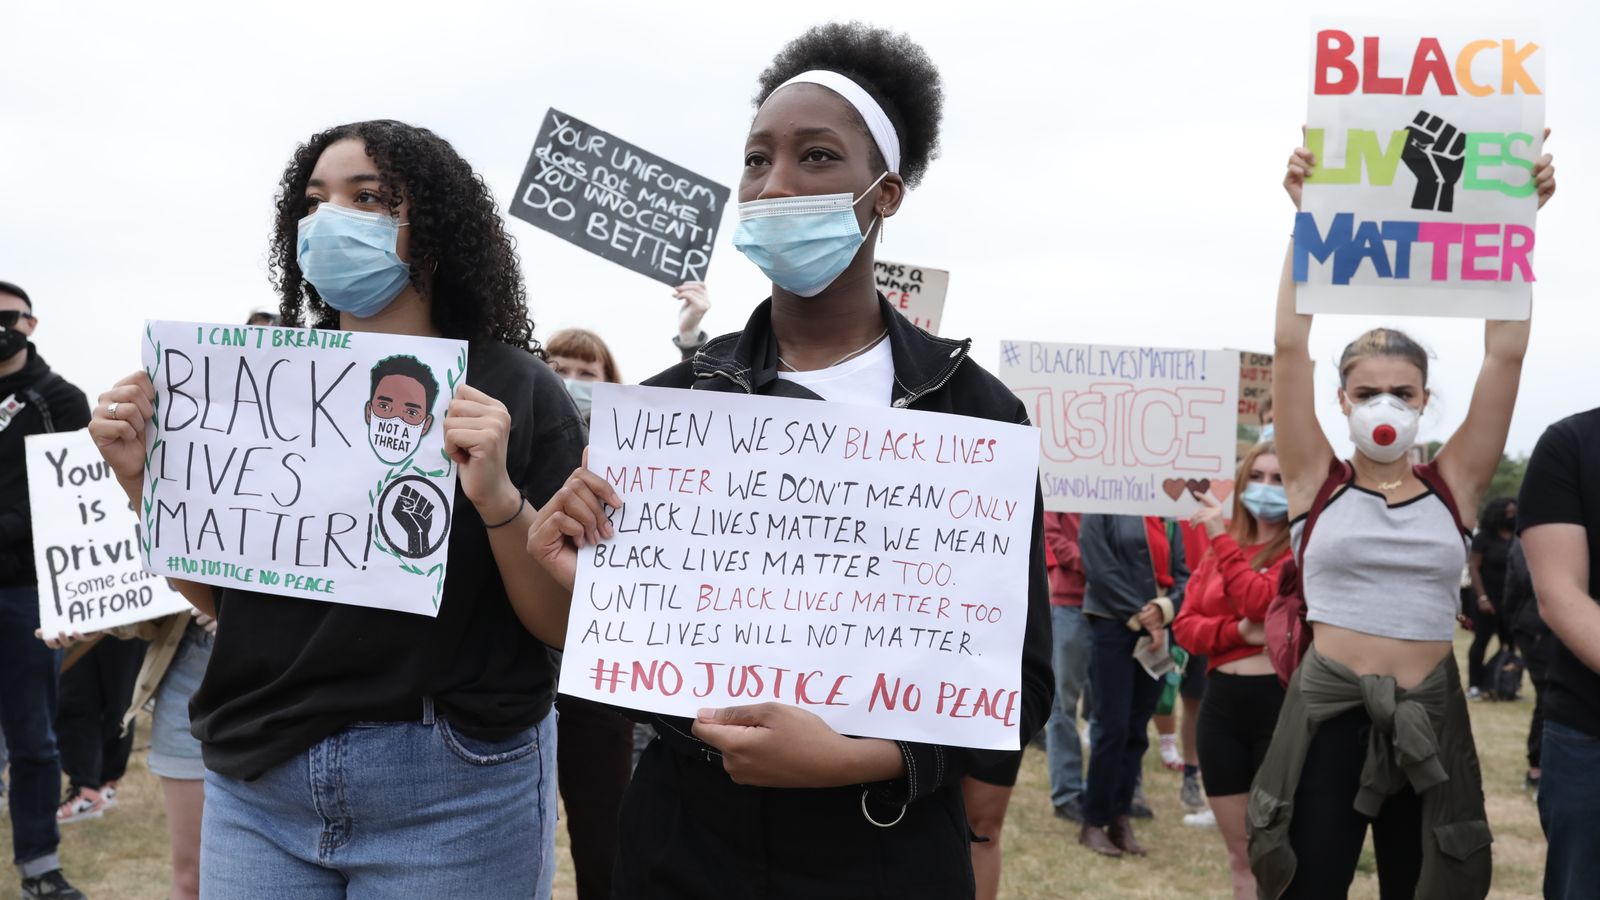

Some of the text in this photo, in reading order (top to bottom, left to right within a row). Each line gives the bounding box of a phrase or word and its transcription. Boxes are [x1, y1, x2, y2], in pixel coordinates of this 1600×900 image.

[1314, 30, 1542, 97] BLACK
[549, 114, 607, 158] YOUR
[1303, 128, 1538, 198] LIVES
[534, 144, 699, 224] does not MAKE
[534, 160, 713, 251] YOU INNOCENT!
[522, 183, 708, 282] DO BETTER
[1292, 212, 1537, 285] MATTER
[198, 327, 352, 349] I CAN'T BREATHE
[165, 349, 356, 448] BLACK
[374, 434, 411, 452] THREAT
[378, 422, 409, 438] NOT A
[613, 408, 996, 464] WHEN WE SAY BLACK LIVES
[160, 441, 306, 507] LIVES
[606, 466, 1018, 522] MATTER WE DON'T MEAN ONLY
[78, 495, 106, 525] is
[156, 500, 373, 571] MATTER!
[691, 506, 760, 536] LIVES
[766, 513, 867, 544] MATTER
[884, 526, 920, 552] WE
[934, 528, 1010, 556] MEAN
[166, 556, 336, 594] #NO JUSTICE NO PEACE
[594, 544, 956, 586] BLACK LIVES MATTER TOO.
[68, 585, 153, 624] AFFORD
[590, 582, 1002, 624] UNTIL BLACK LIVES MATTER TOO
[581, 620, 982, 656] ALL LIVES WILL NOT MATTER.
[590, 658, 1020, 726] #NO JUSTICE NO PEACE
